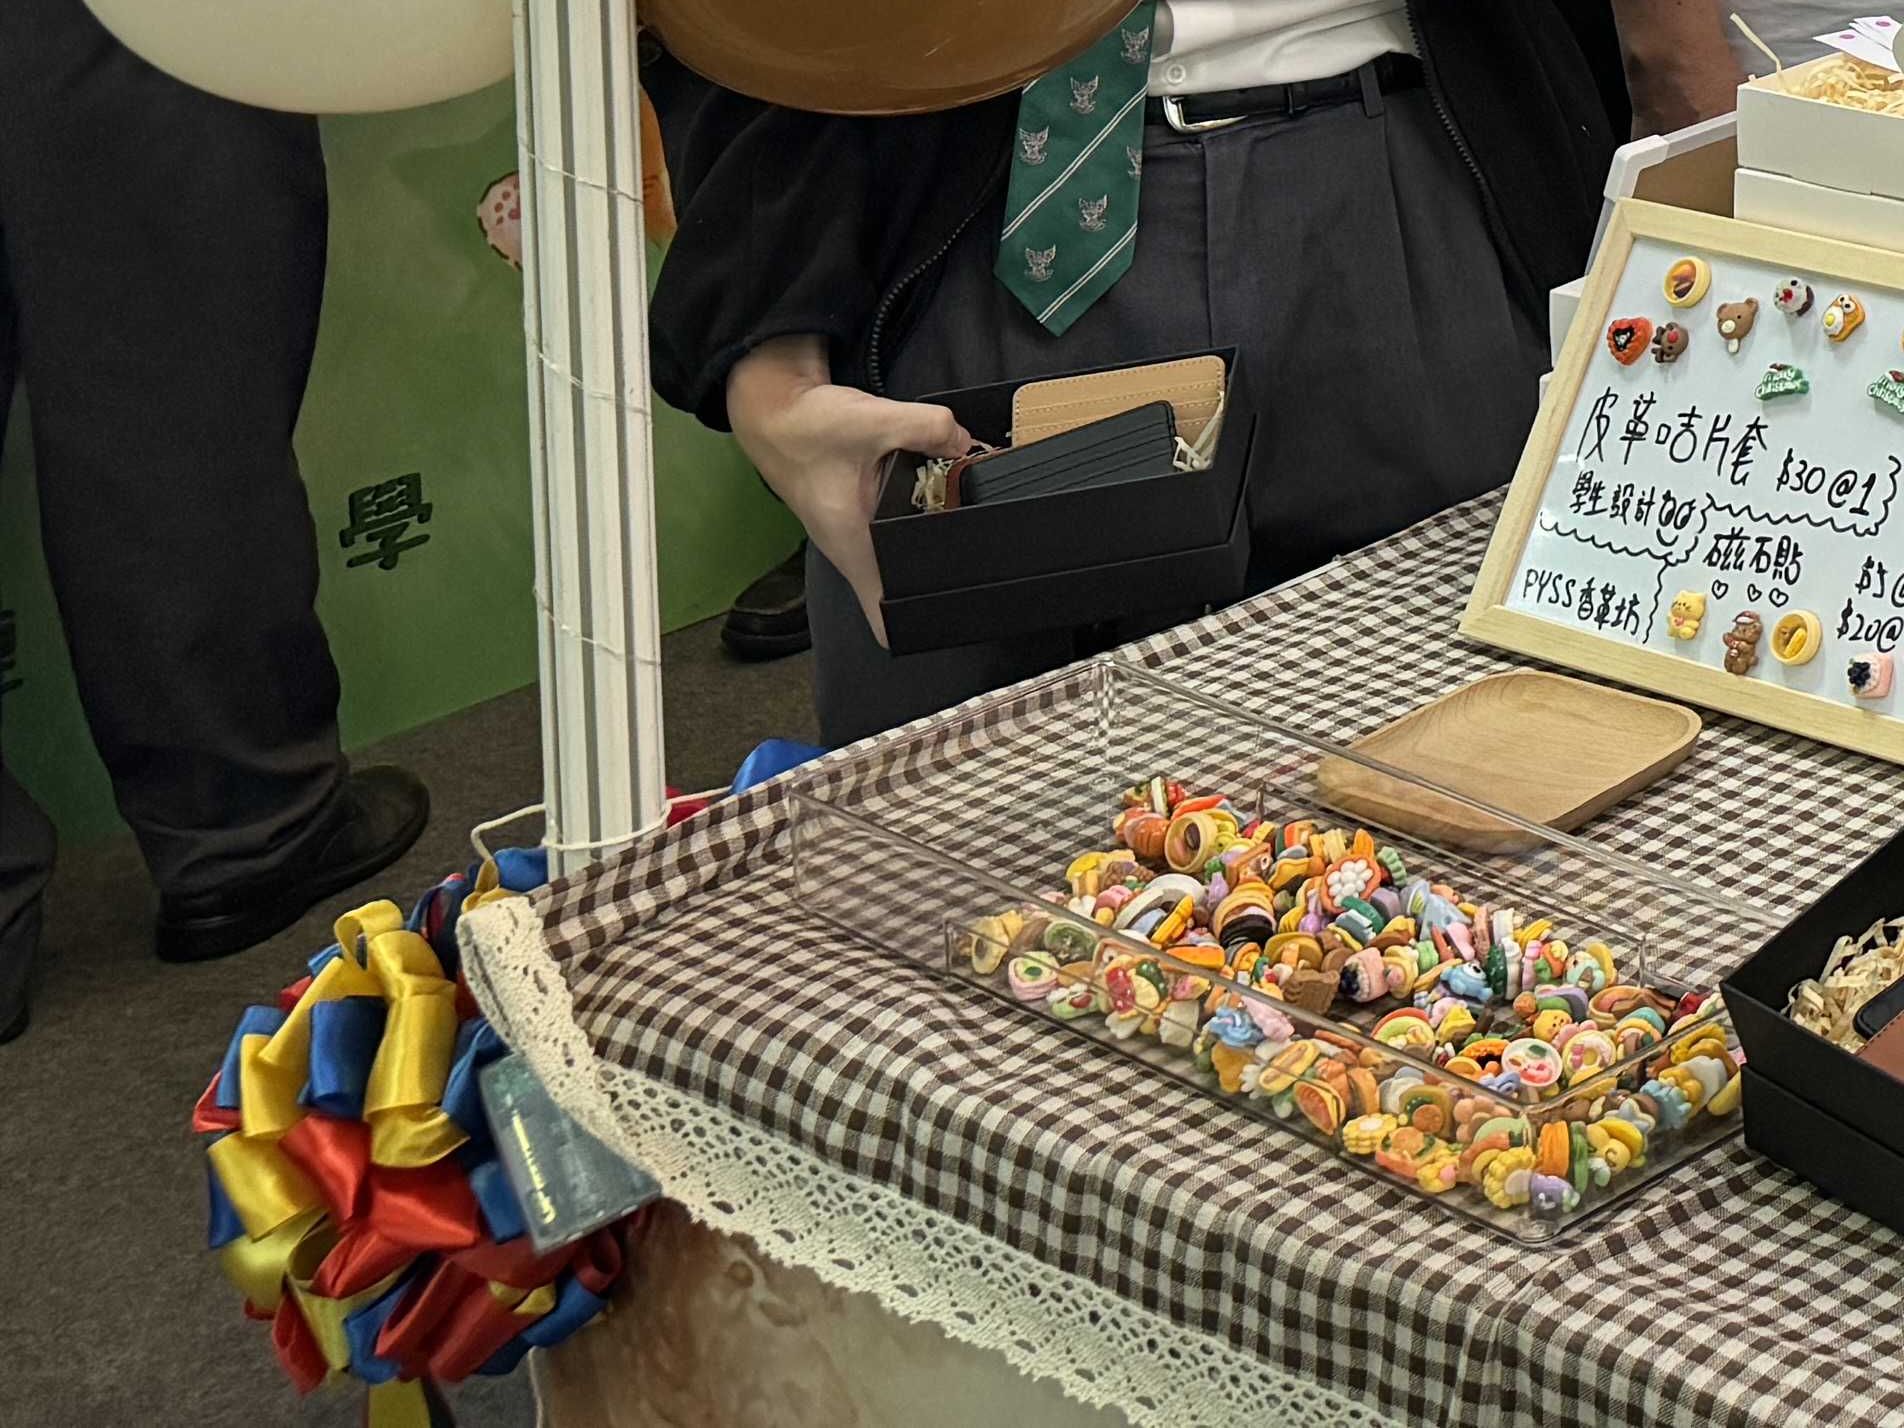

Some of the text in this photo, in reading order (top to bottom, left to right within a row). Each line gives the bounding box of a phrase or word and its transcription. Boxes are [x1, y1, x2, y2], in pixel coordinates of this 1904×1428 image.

[339, 472, 433, 571] 學
[1702, 527, 1804, 586] 磁石貼
